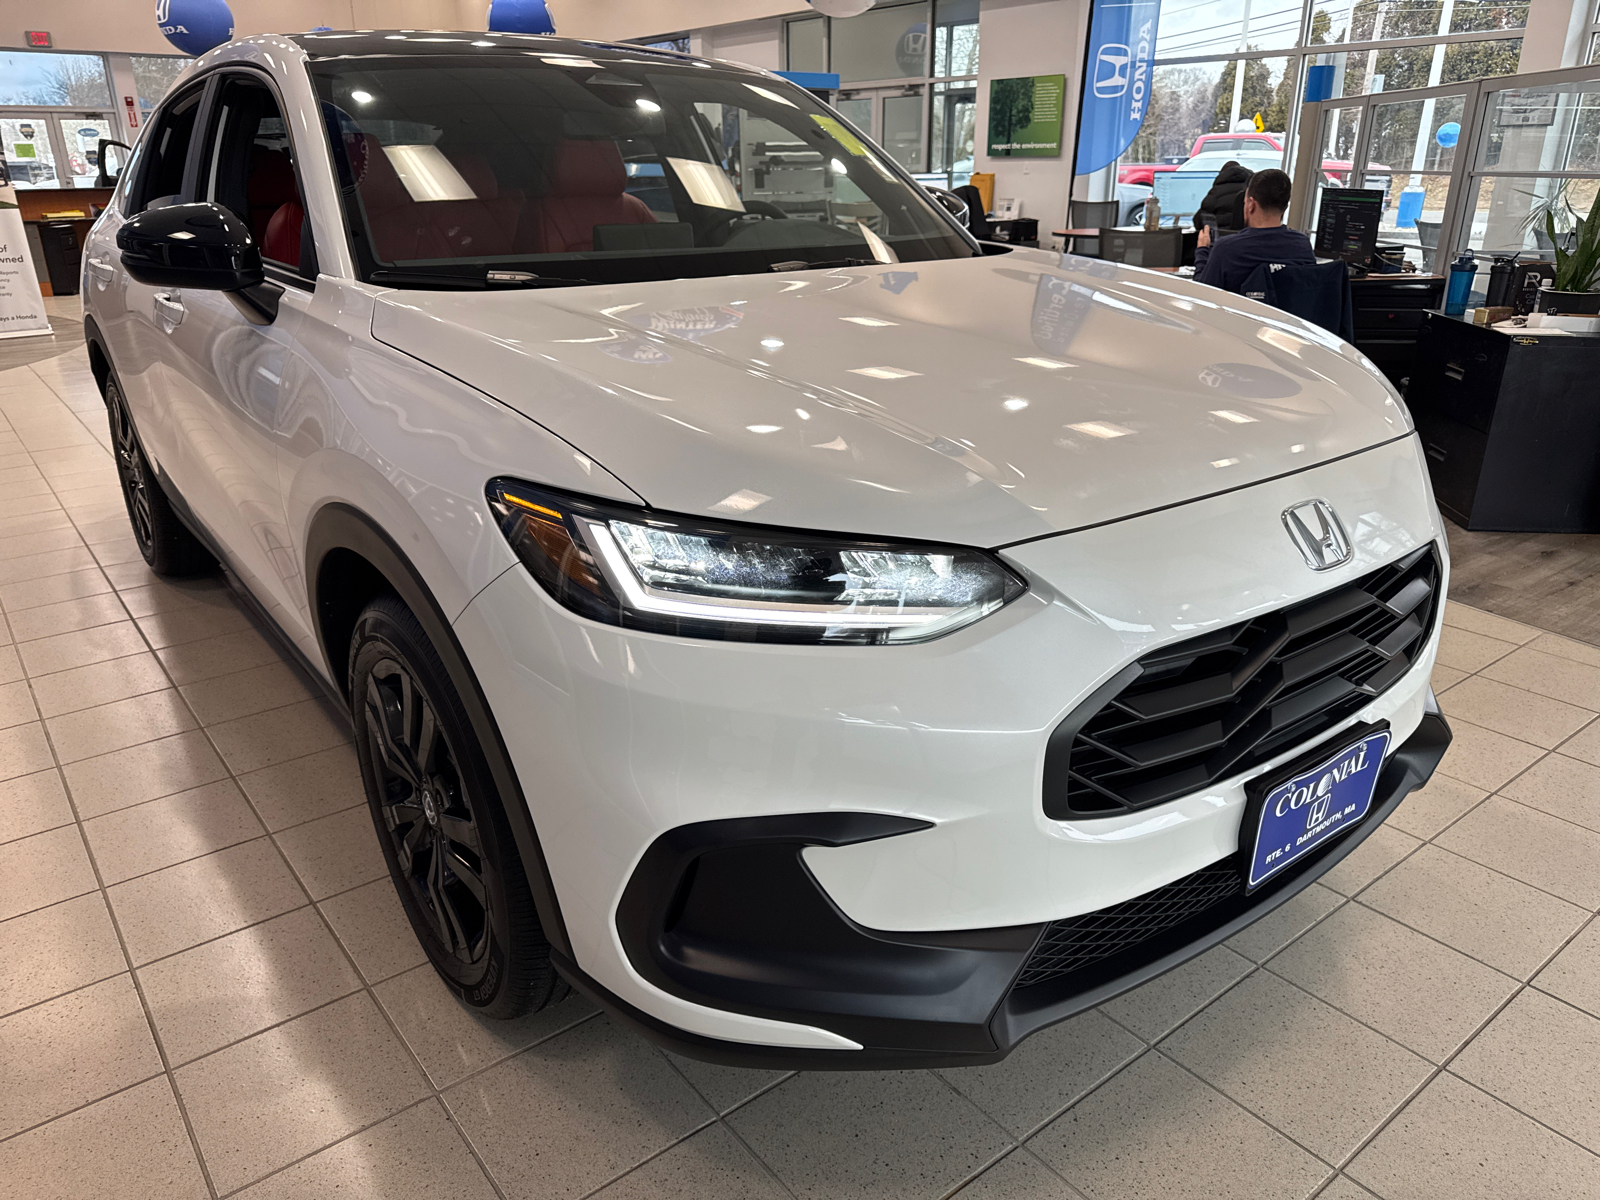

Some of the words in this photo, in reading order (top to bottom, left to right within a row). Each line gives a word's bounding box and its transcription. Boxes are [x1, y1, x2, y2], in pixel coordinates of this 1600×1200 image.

[1130, 19, 1152, 121] HONDA
[991, 143, 1011, 151] respect
[1011, 141, 1021, 149] the
[1021, 141, 1057, 149] environment
[1275, 750, 1370, 818] COLONIAL
[1265, 849, 1283, 864] RTE.
[1284, 843, 1291, 852] 6
[1344, 803, 1356, 815] MA
